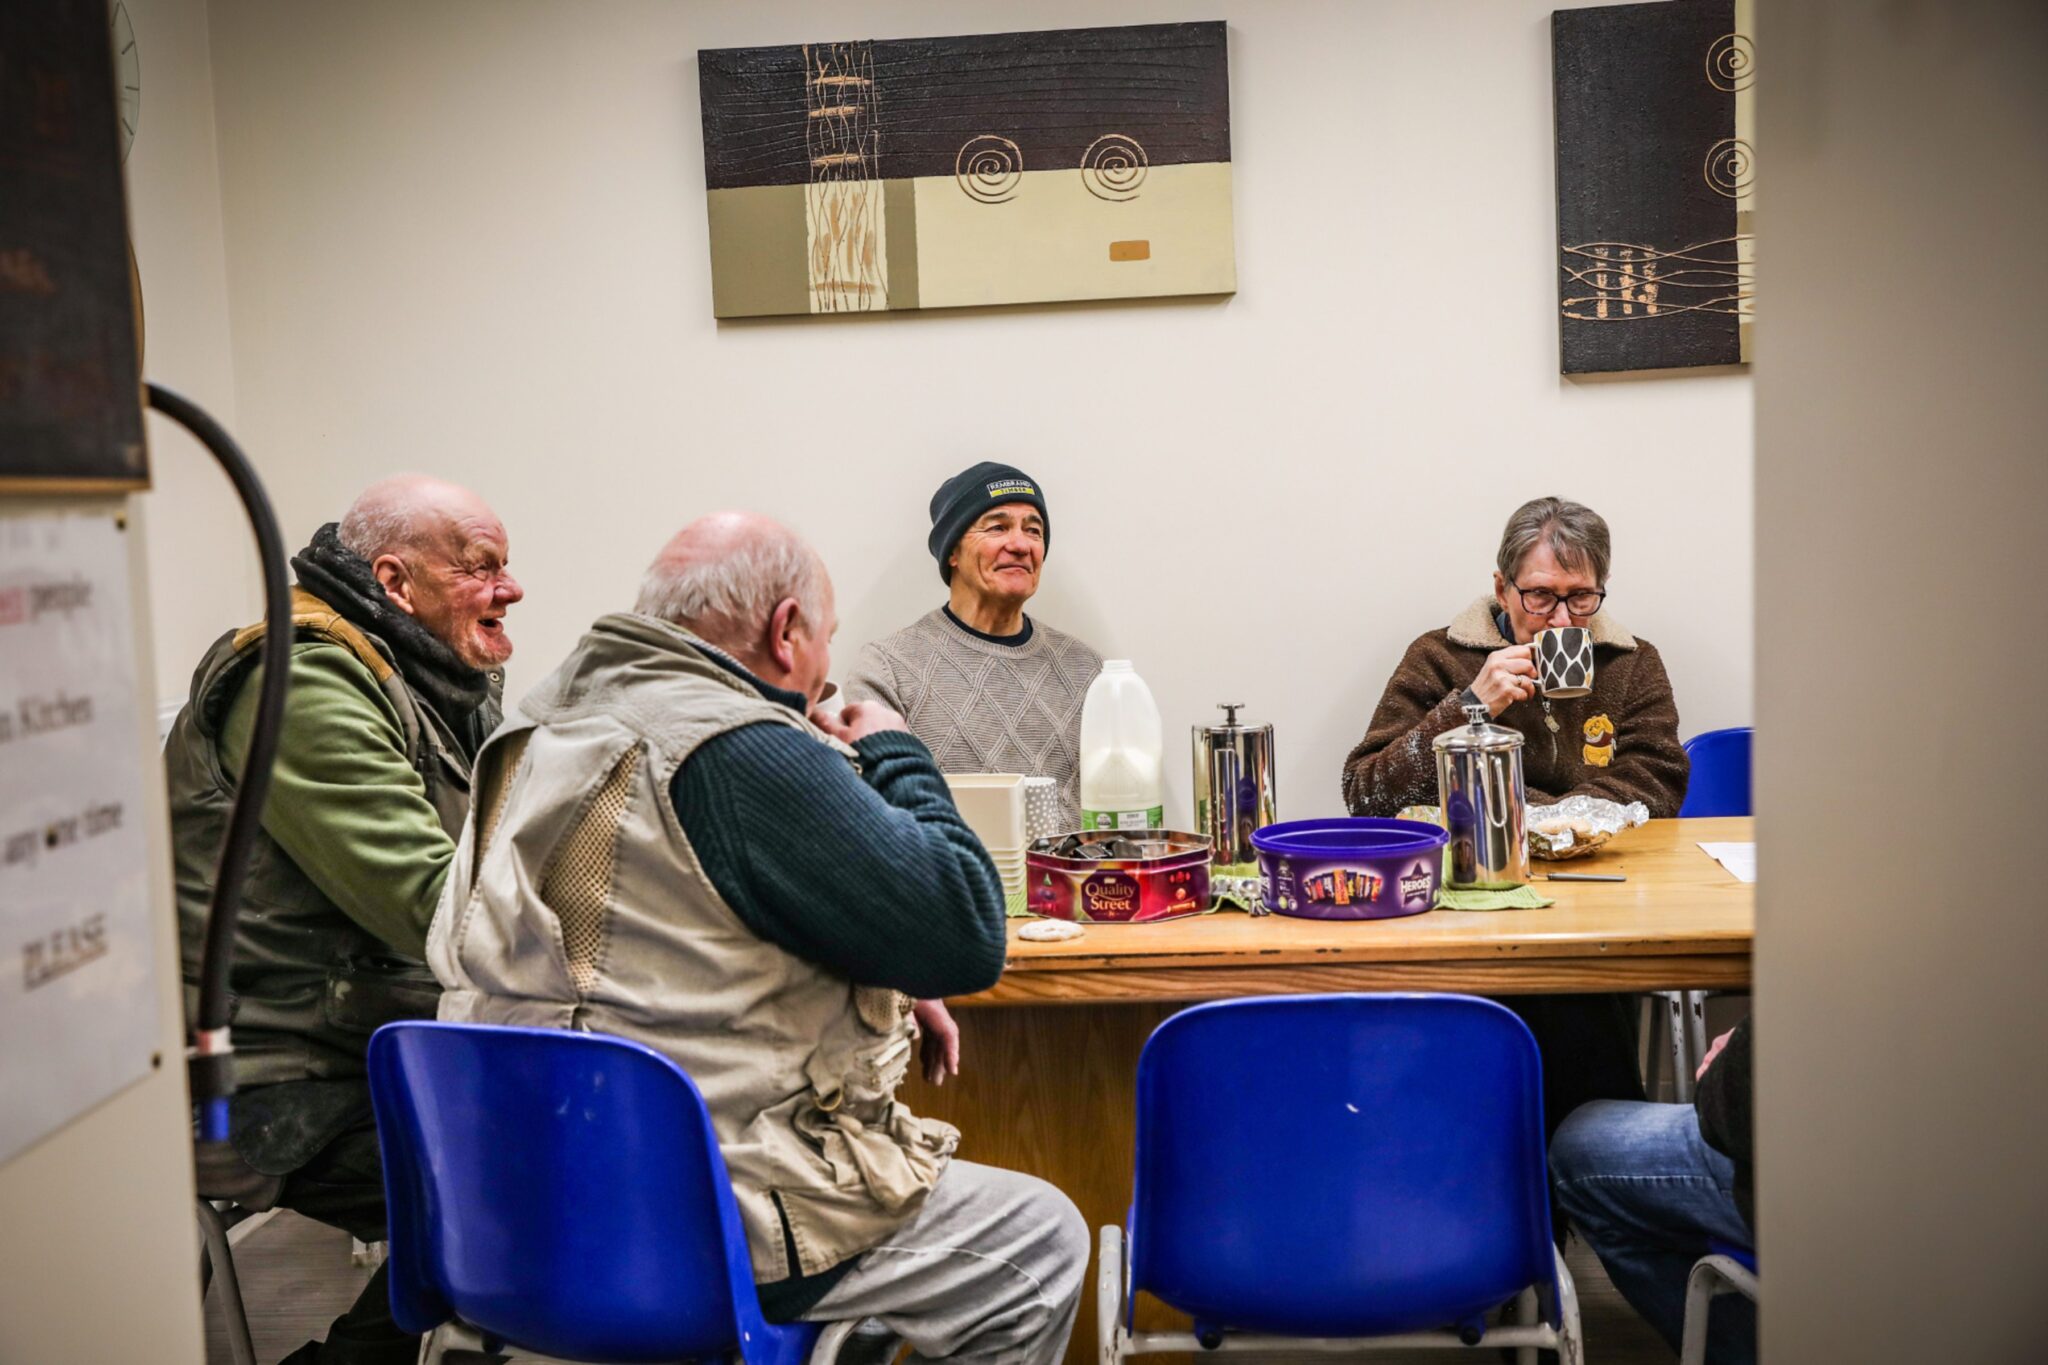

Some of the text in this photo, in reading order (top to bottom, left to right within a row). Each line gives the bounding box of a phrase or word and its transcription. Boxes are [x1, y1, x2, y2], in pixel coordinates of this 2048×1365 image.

[1085, 882, 1136, 899] Quality
[1400, 876, 1431, 894] HEROES
[1090, 896, 1132, 911] Street
